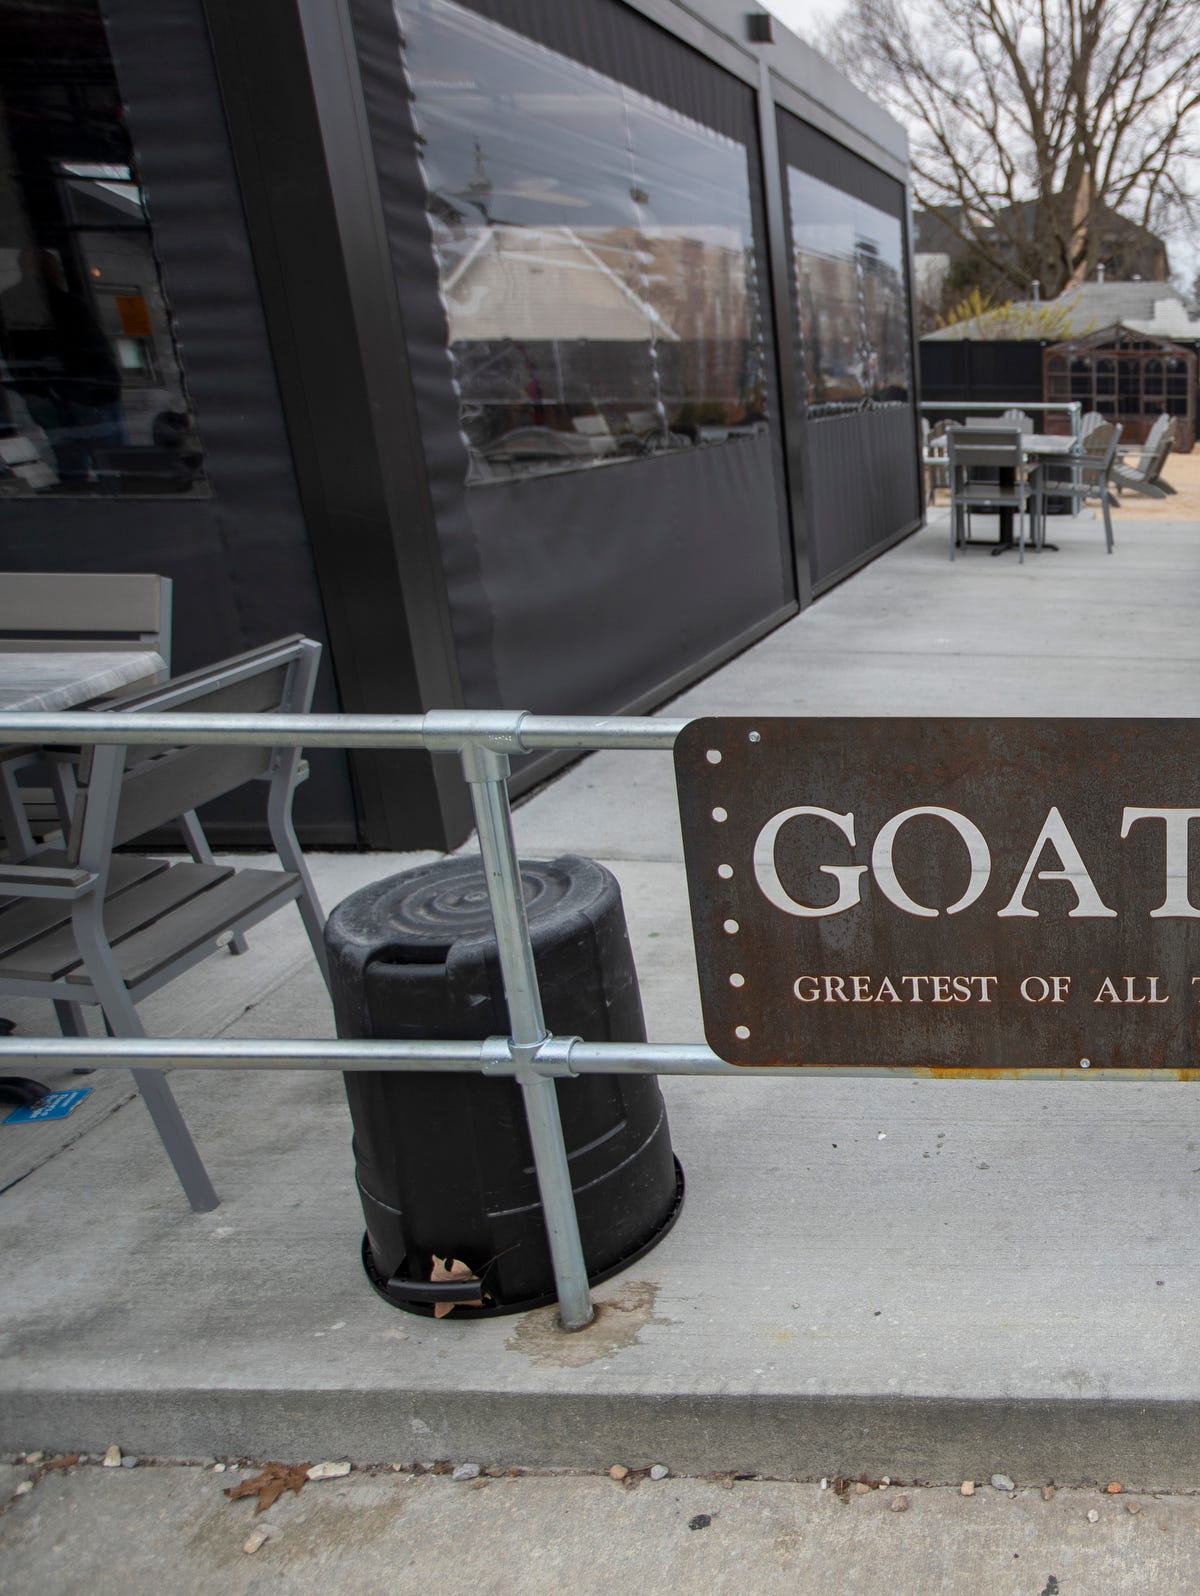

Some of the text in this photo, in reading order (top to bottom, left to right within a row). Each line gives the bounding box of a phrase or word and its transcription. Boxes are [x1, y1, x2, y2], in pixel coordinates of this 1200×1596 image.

[793, 975, 998, 1003] GREATEST
[1020, 975, 1072, 1003] OF
[1094, 975, 1170, 1003] ALL
